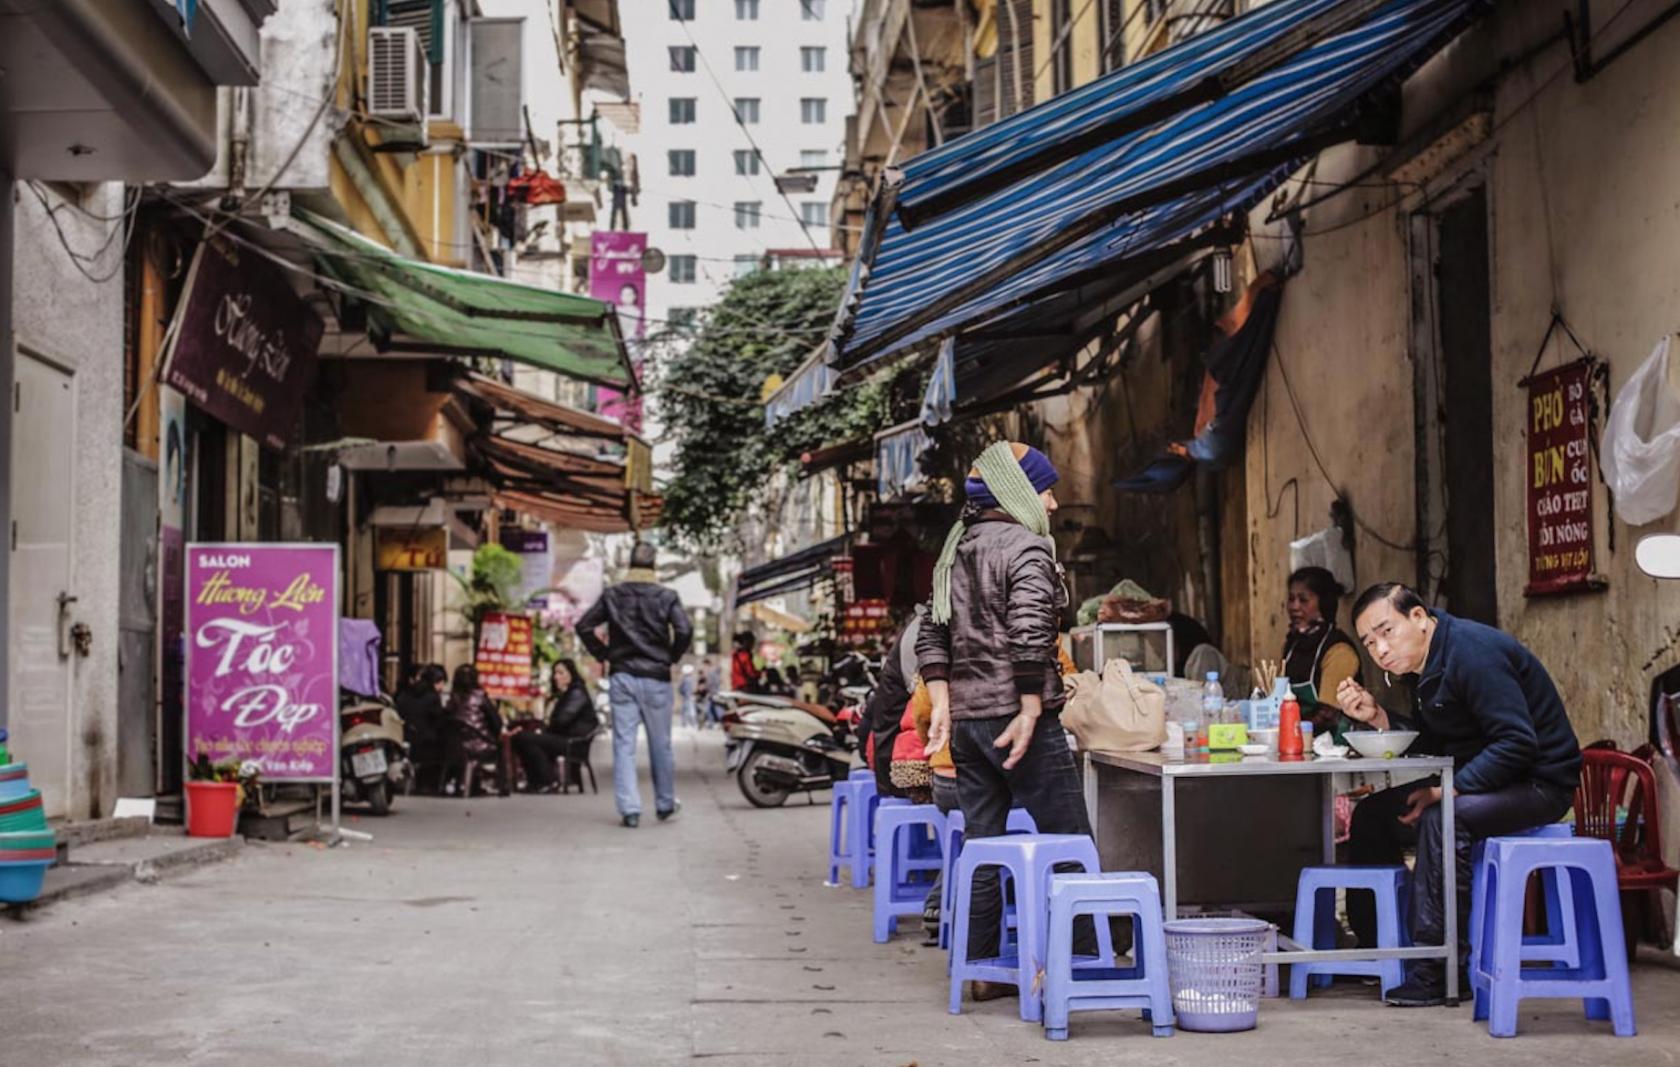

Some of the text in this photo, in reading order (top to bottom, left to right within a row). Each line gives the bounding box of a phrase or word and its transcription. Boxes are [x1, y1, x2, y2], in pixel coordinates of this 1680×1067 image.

[1534, 376, 1564, 433] PHỞ
[198, 555, 251, 568] SALON
[196, 617, 294, 677] Tóc
[221, 684, 318, 733] Đẹp
